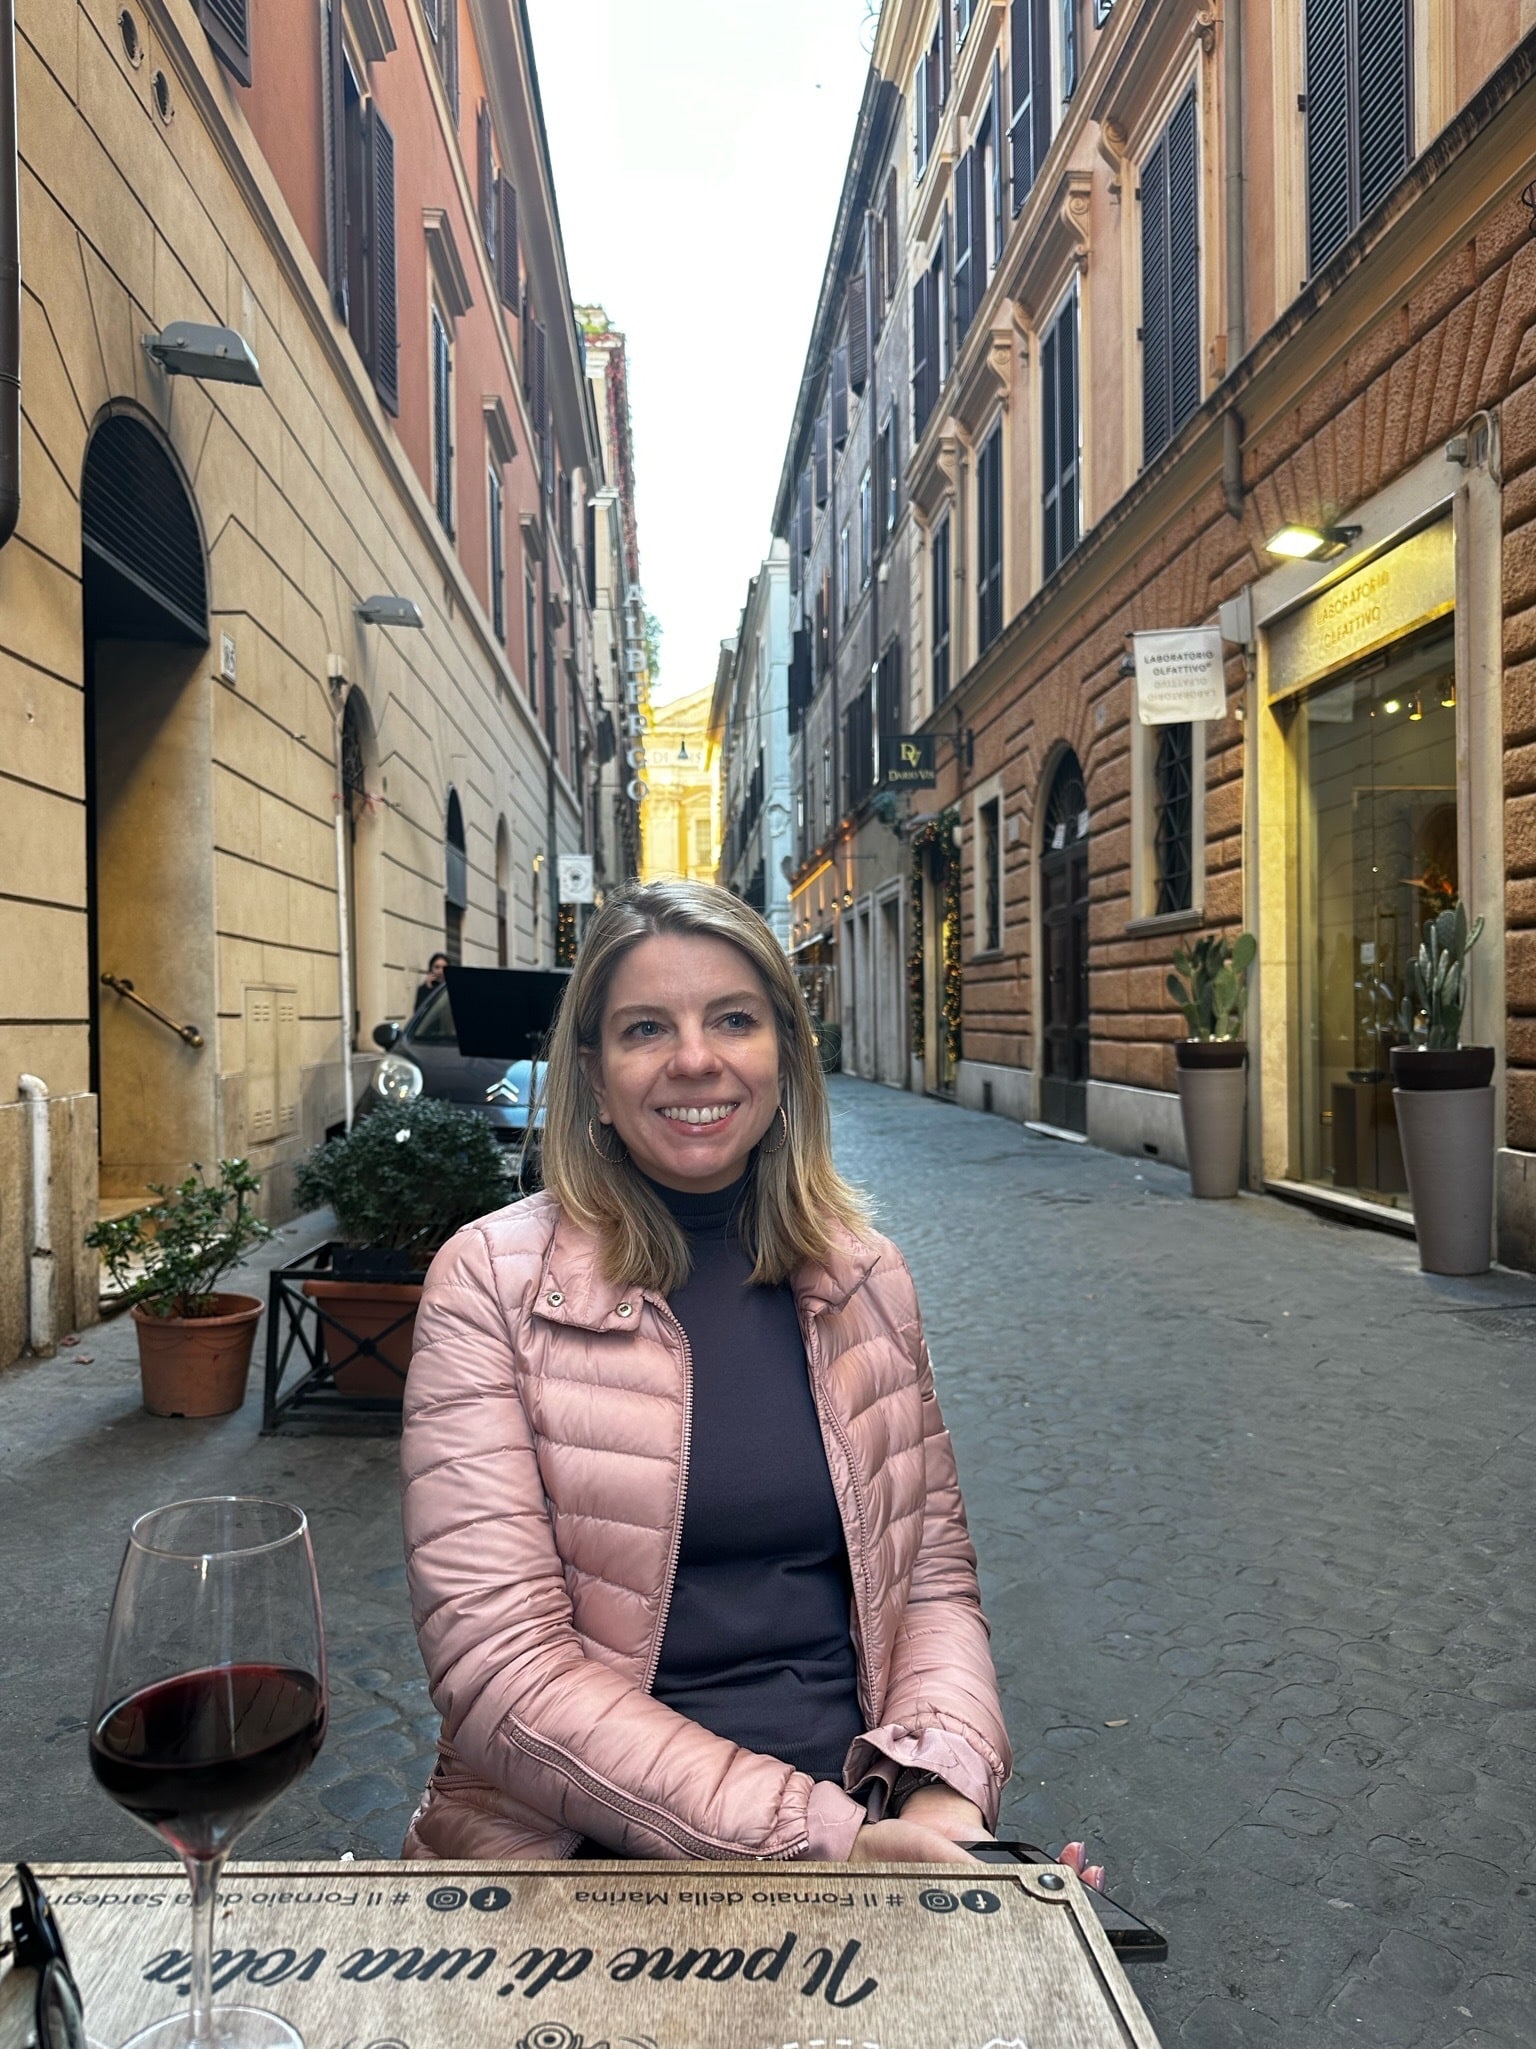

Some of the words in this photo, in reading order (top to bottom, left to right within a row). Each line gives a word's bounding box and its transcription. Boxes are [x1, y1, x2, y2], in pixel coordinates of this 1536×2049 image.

[1316, 570, 1389, 626] LABORATORIO
[1324, 606, 1381, 648] OLFATTIVO
[1143, 650, 1214, 664] LABORATORIO
[622, 585, 649, 801] ALBERGO
[175, 1892, 243, 1907] dea
[251, 1891, 362, 1907] Fornaio
[367, 1892, 381, 1906] Il
[391, 1892, 411, 1906] #
[575, 1891, 669, 1906] Marina
[679, 1891, 744, 1906] della
[752, 1891, 855, 1907] Fornaio
[865, 1892, 878, 1907] Il
[886, 1892, 904, 1907] #
[336, 1946, 498, 1983] una
[606, 1931, 797, 1982] pane
[496, 1946, 594, 1999] di
[802, 1938, 879, 2008] Il
